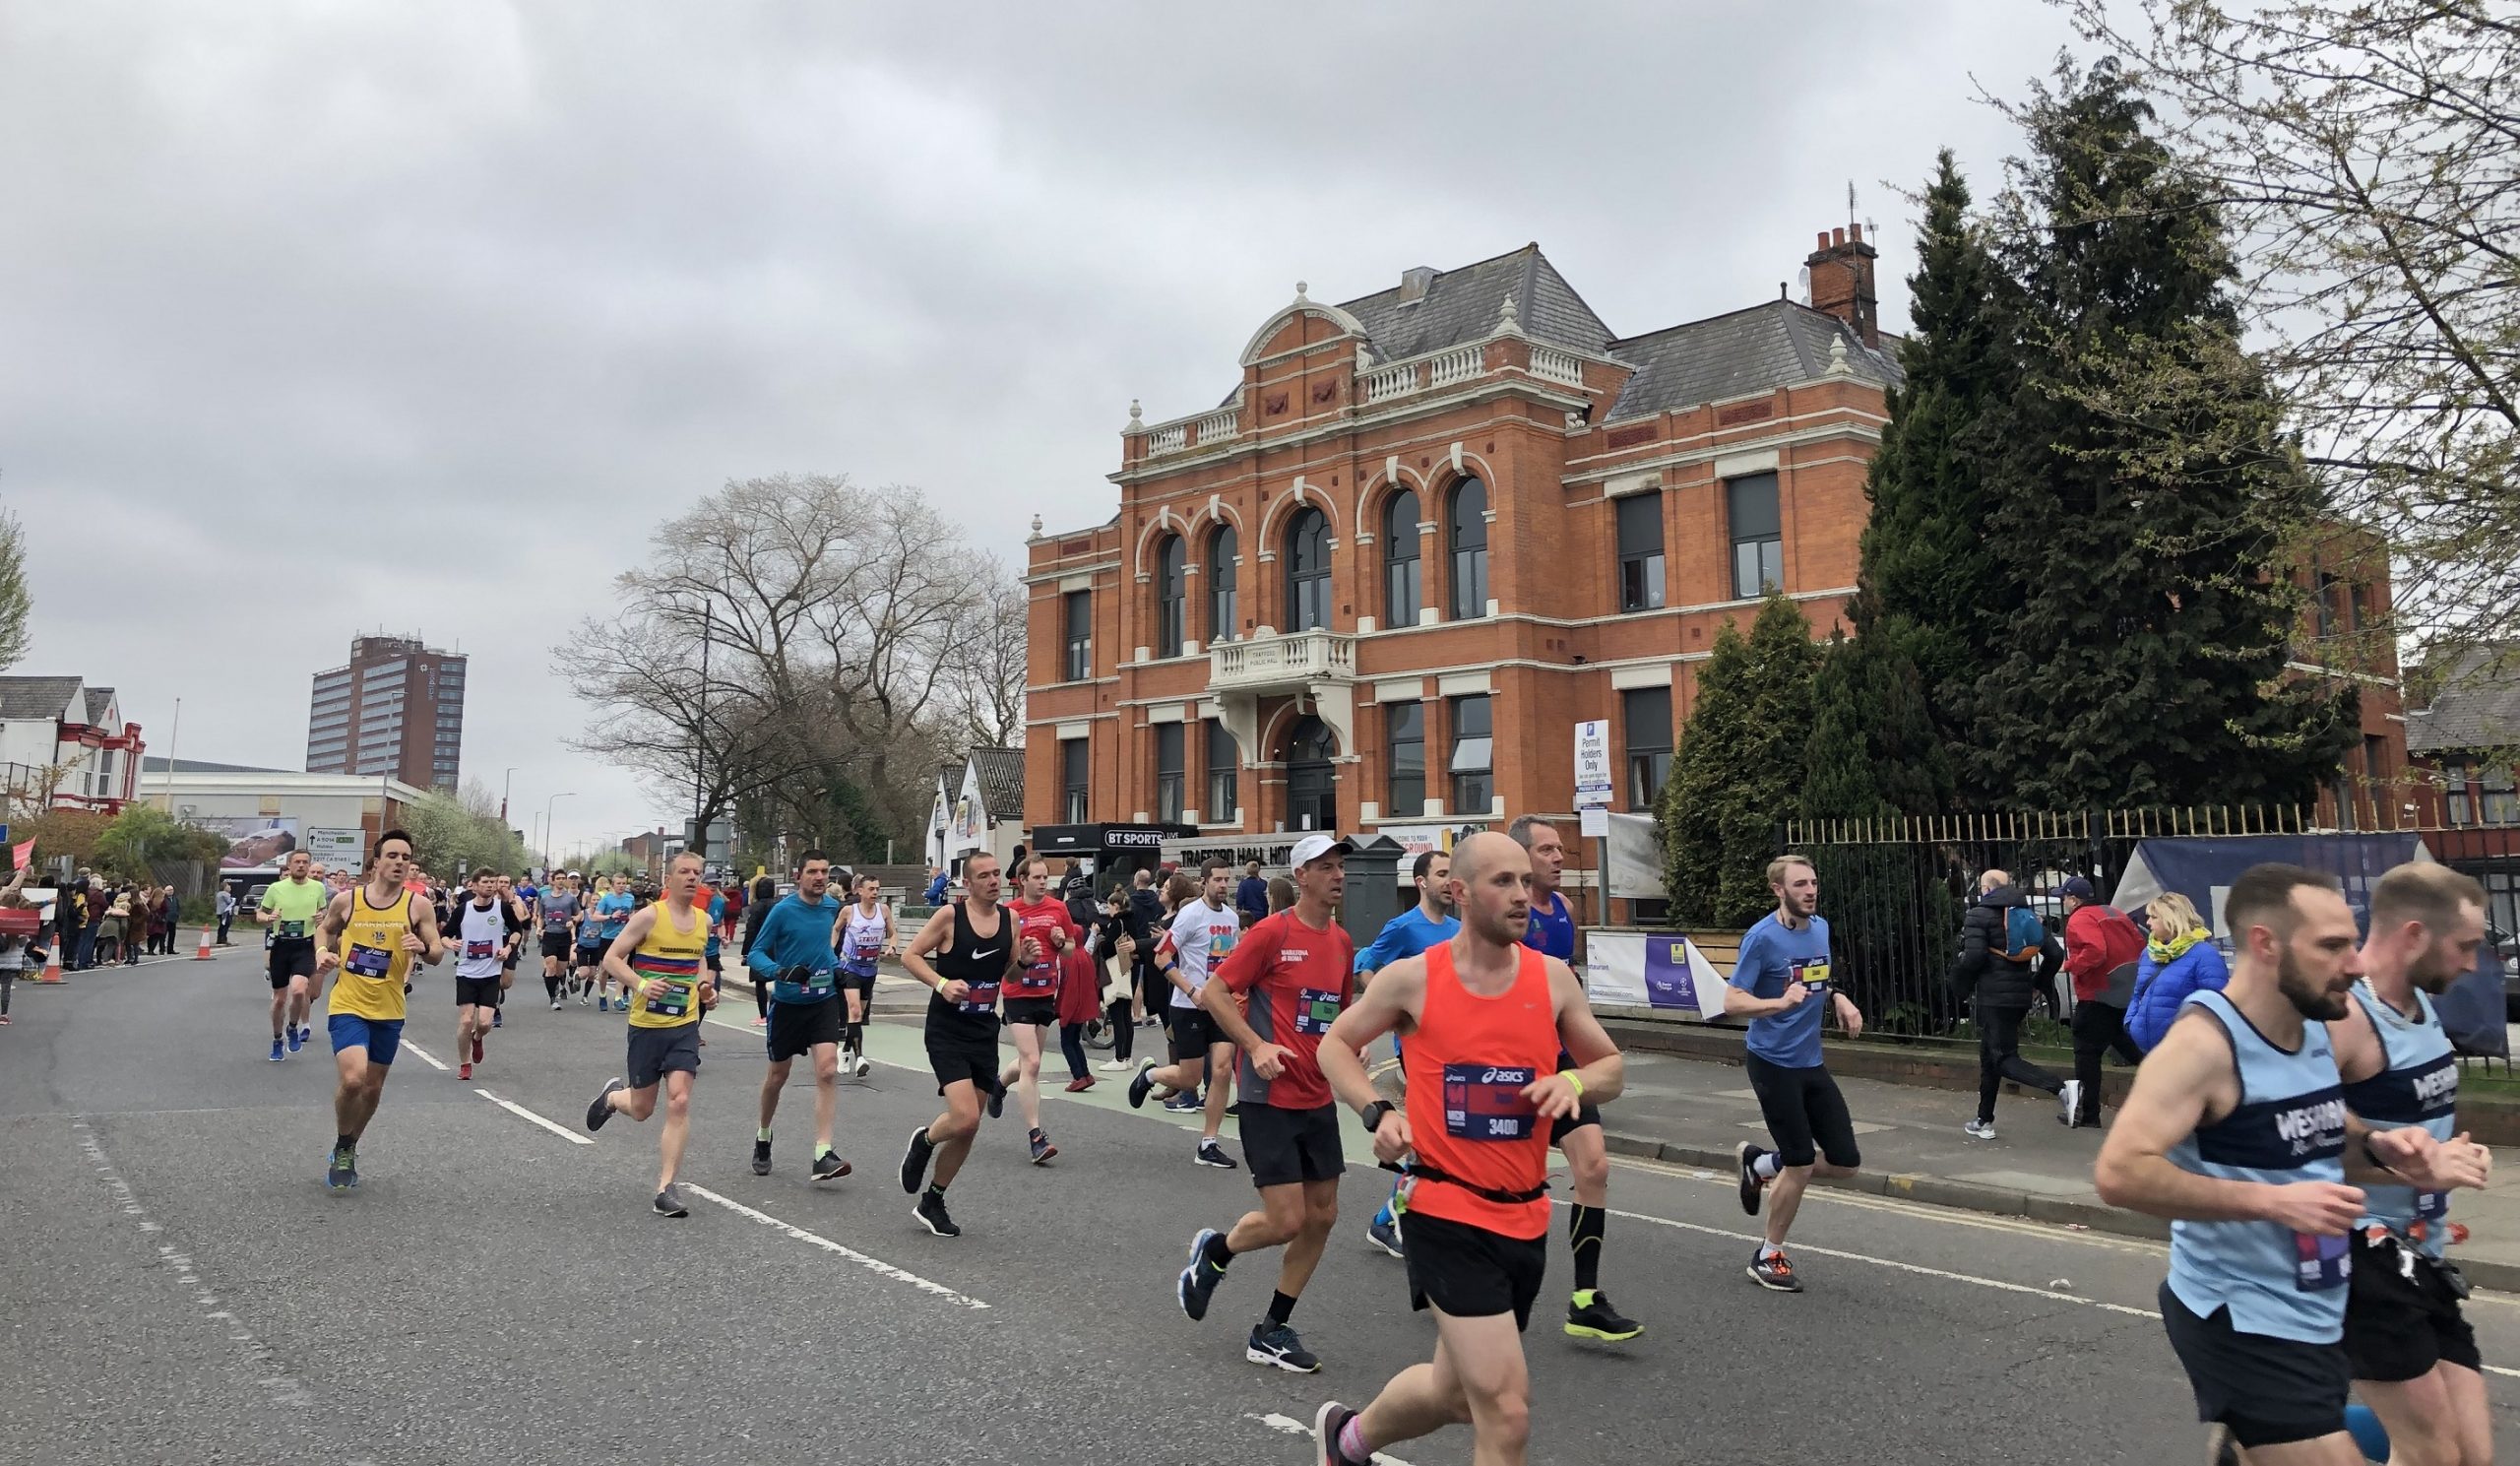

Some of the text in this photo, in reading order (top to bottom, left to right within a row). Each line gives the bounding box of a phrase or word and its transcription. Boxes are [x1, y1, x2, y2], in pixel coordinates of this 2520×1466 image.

[1582, 737, 1601, 747] Permit
[1581, 748, 1603, 759] Holders
[1585, 760, 1598, 771] Only
[1108, 834, 1120, 843] BT
[1123, 834, 1162, 845] SPORTS
[1269, 845, 1292, 865] HOT
[1489, 1118, 1518, 1135] 3400
